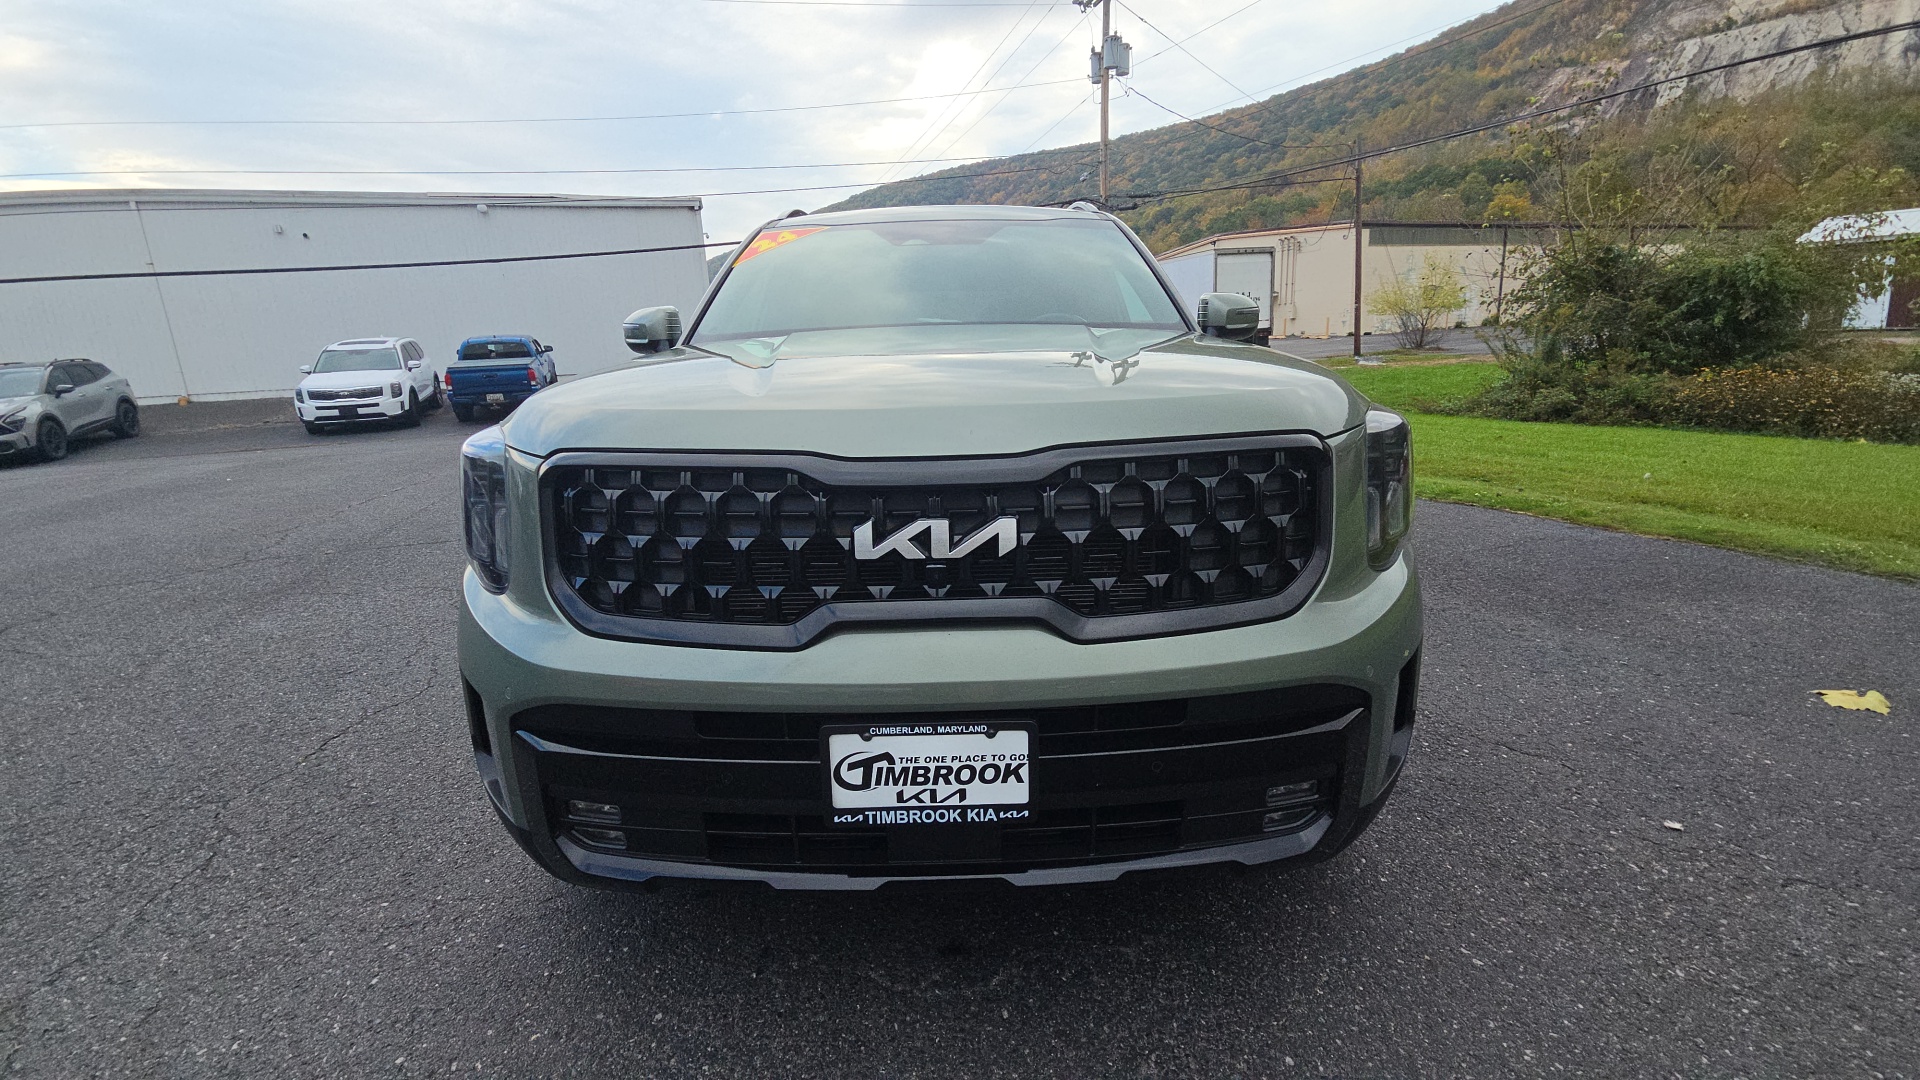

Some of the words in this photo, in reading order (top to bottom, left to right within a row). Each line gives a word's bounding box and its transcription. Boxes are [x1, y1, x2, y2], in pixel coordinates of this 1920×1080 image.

[853, 515, 1018, 559] KIA
[869, 726, 935, 735] CUMBERLAND,
[937, 725, 987, 734] MARYLAND
[898, 756, 920, 764] THE
[924, 755, 947, 763] ONE
[951, 754, 987, 763] PLACE
[991, 754, 1006, 762] TO
[834, 752, 1028, 792] TIMBROOK
[896, 788, 967, 804] KIA
[865, 810, 961, 824] TIMBROOK
[967, 808, 998, 822] KIA
